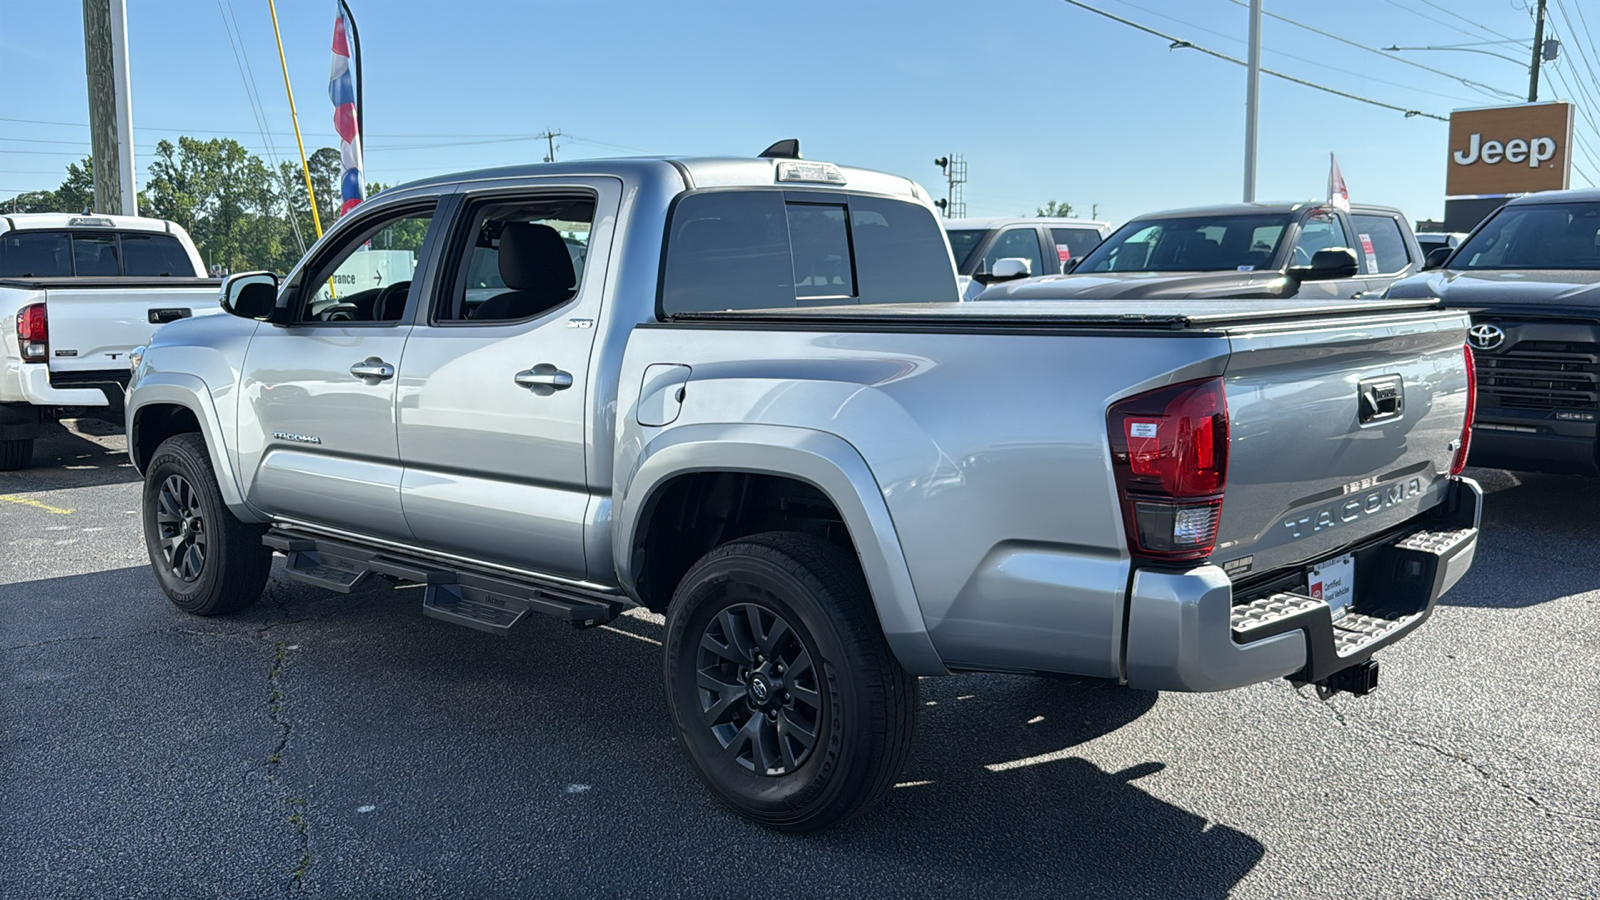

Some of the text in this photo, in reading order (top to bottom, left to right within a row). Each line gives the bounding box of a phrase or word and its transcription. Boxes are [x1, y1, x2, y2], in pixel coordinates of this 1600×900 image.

[1453, 132, 1556, 168] Jeep
[324, 273, 356, 285] trance
[271, 431, 322, 445] TACOMA
[1284, 477, 1421, 538] TACOMA
